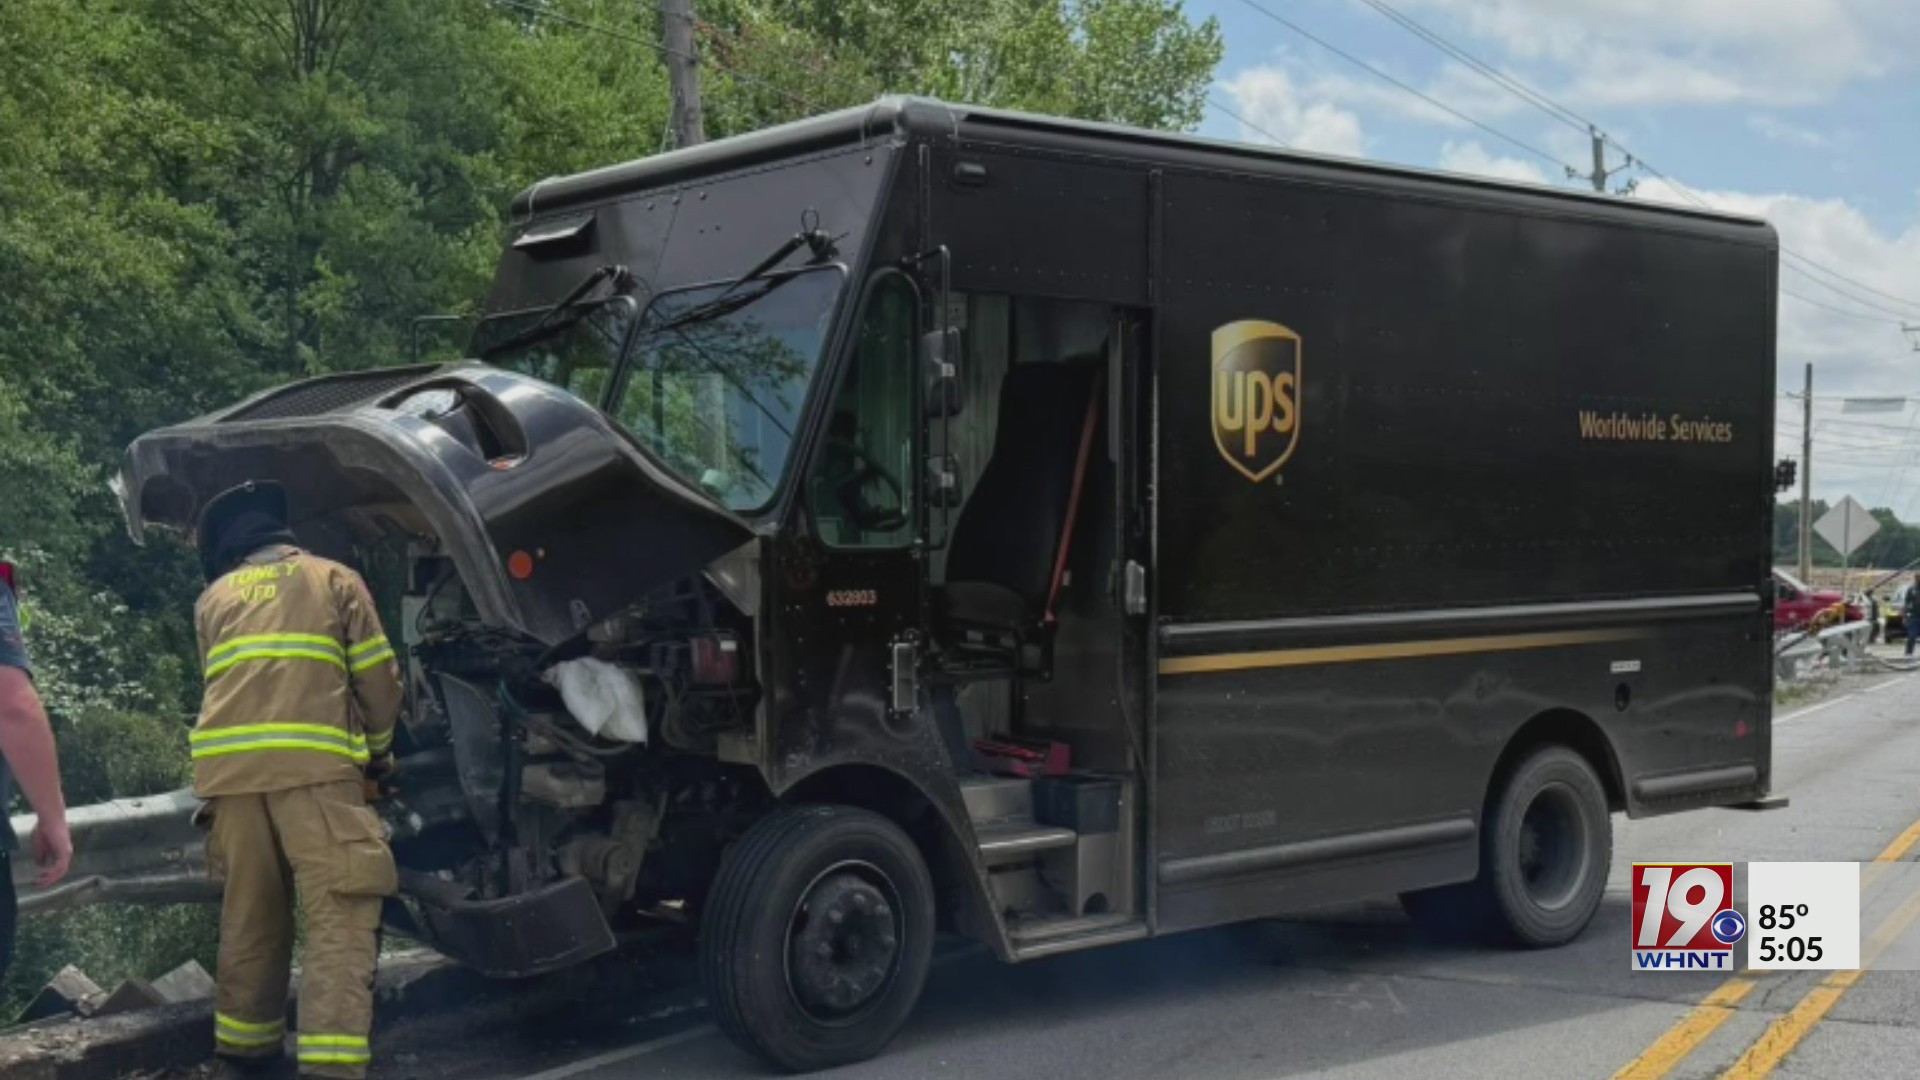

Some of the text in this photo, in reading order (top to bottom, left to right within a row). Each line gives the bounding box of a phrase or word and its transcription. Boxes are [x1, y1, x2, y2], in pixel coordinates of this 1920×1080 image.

[1218, 370, 1295, 457] ups
[1579, 410, 1733, 442] Worldwide Services
[227, 561, 300, 588] TONEY
[241, 584, 276, 602] VFD
